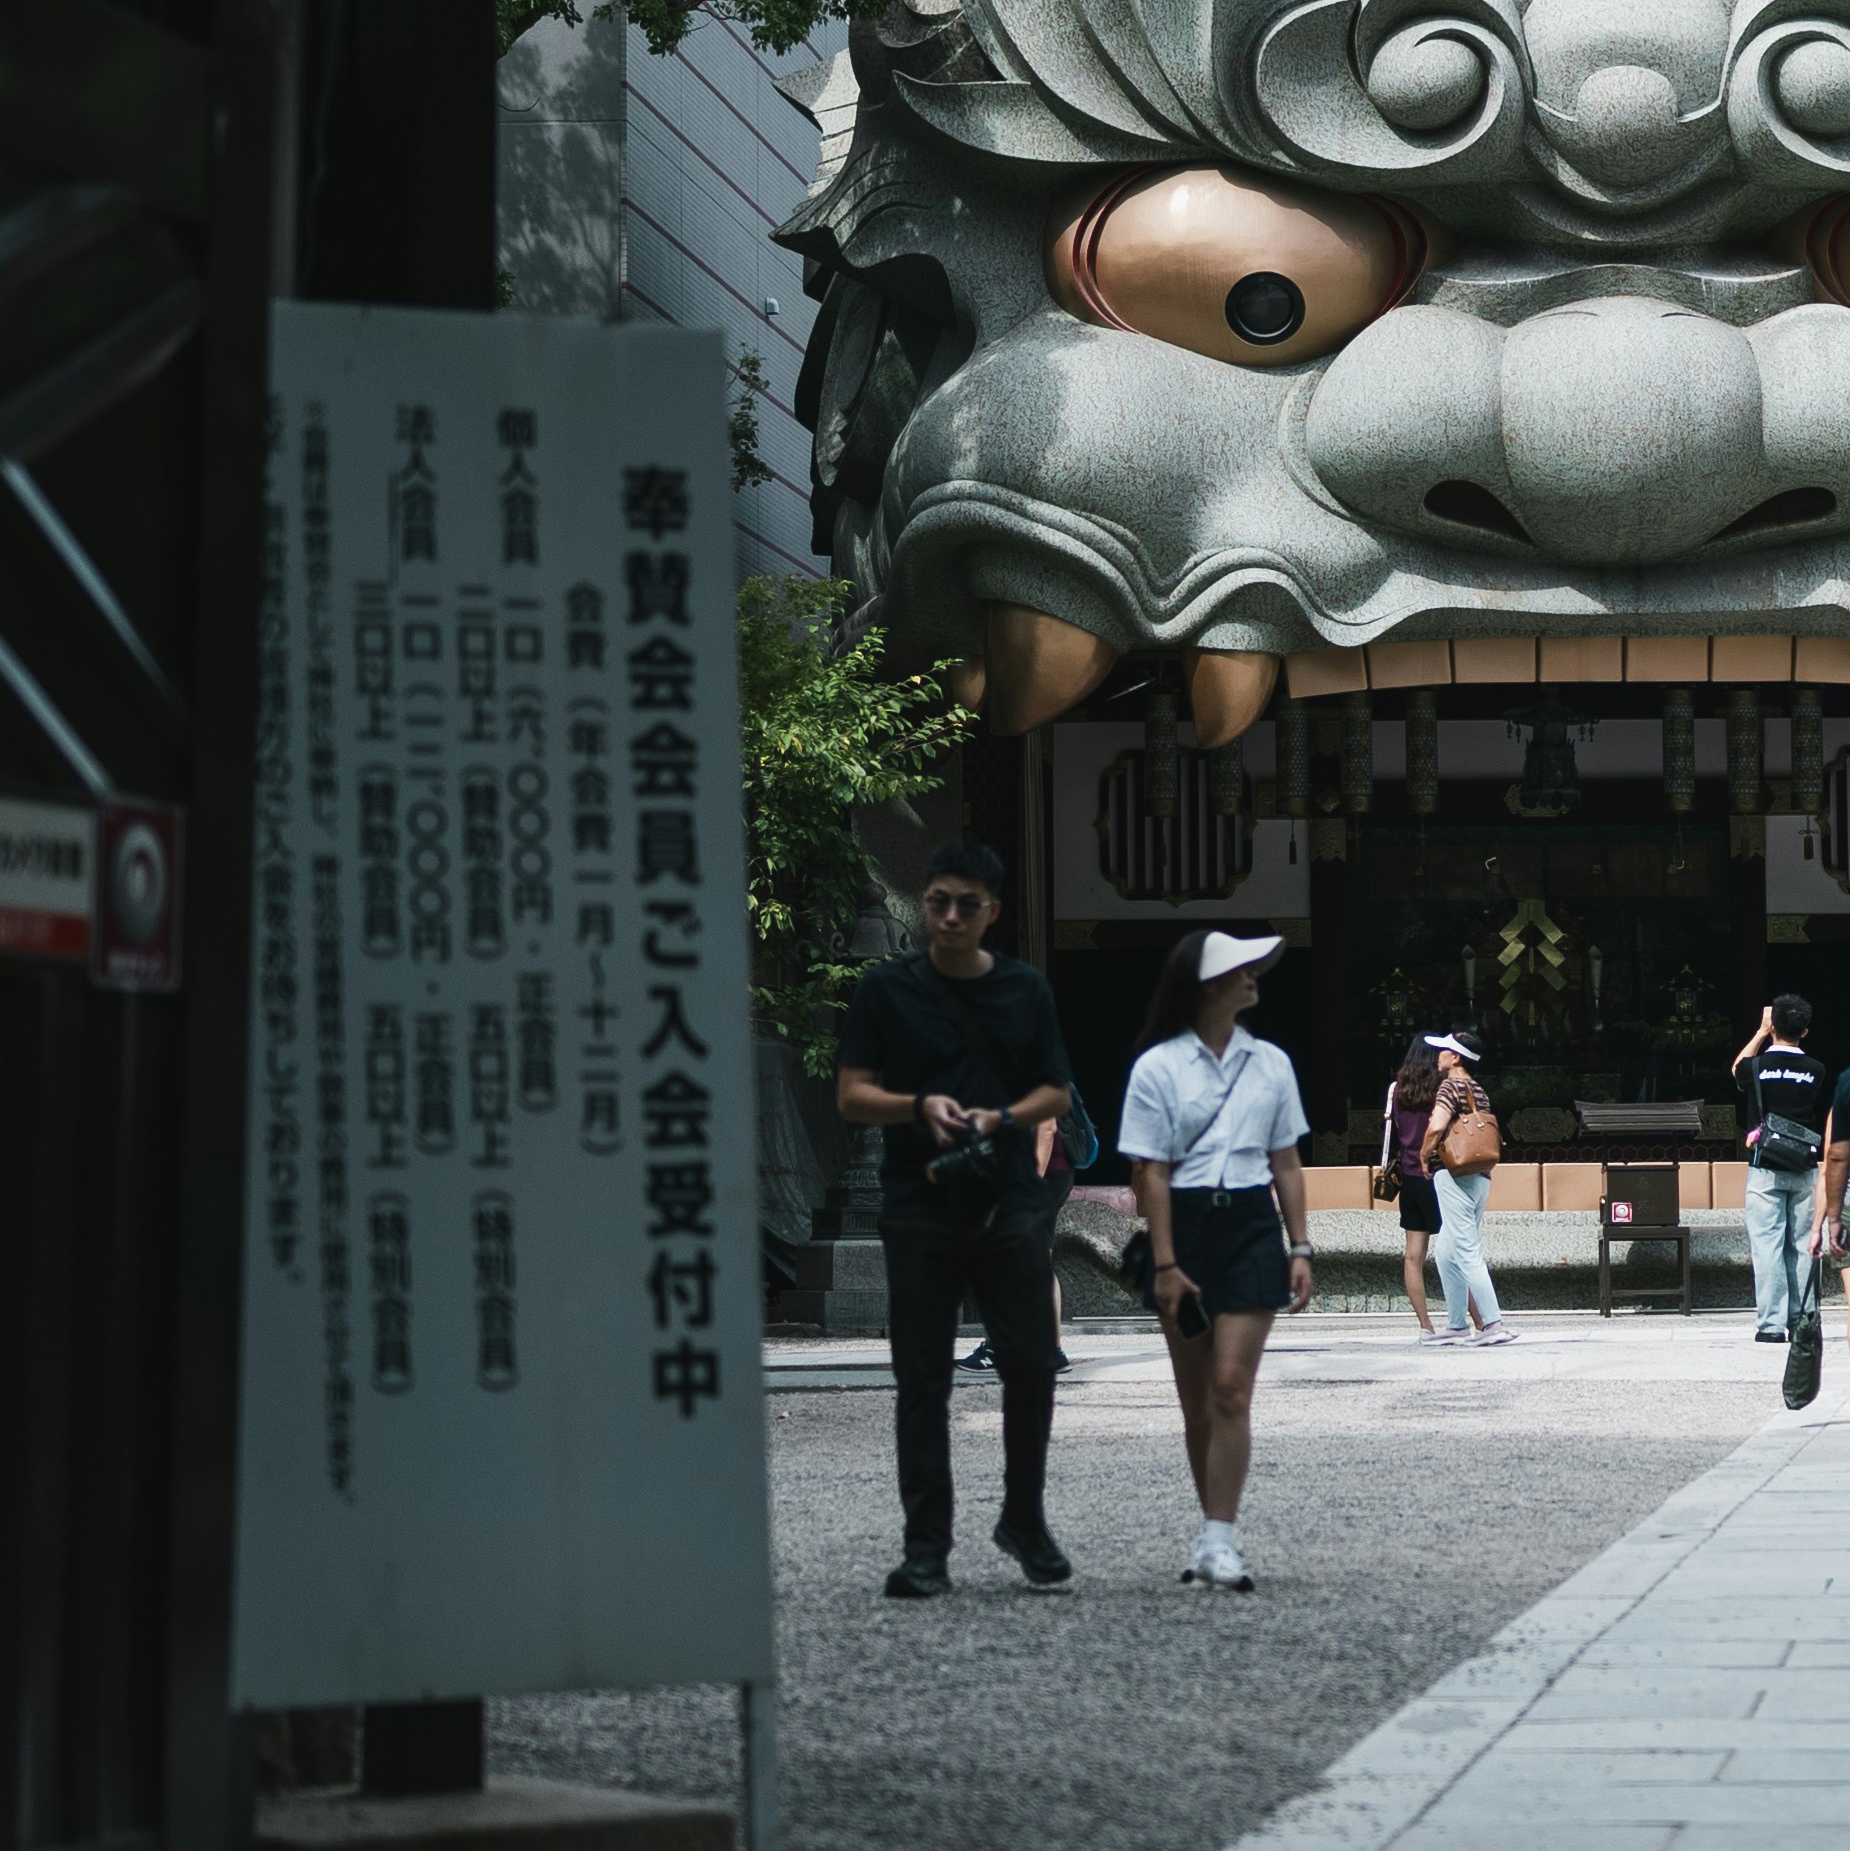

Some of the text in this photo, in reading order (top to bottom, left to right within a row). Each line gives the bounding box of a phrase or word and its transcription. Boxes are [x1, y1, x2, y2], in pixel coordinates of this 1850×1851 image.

[620, 462, 723, 1419] 奉賛会会員ご入会受付中
[980, 1357, 994, 1368] N
